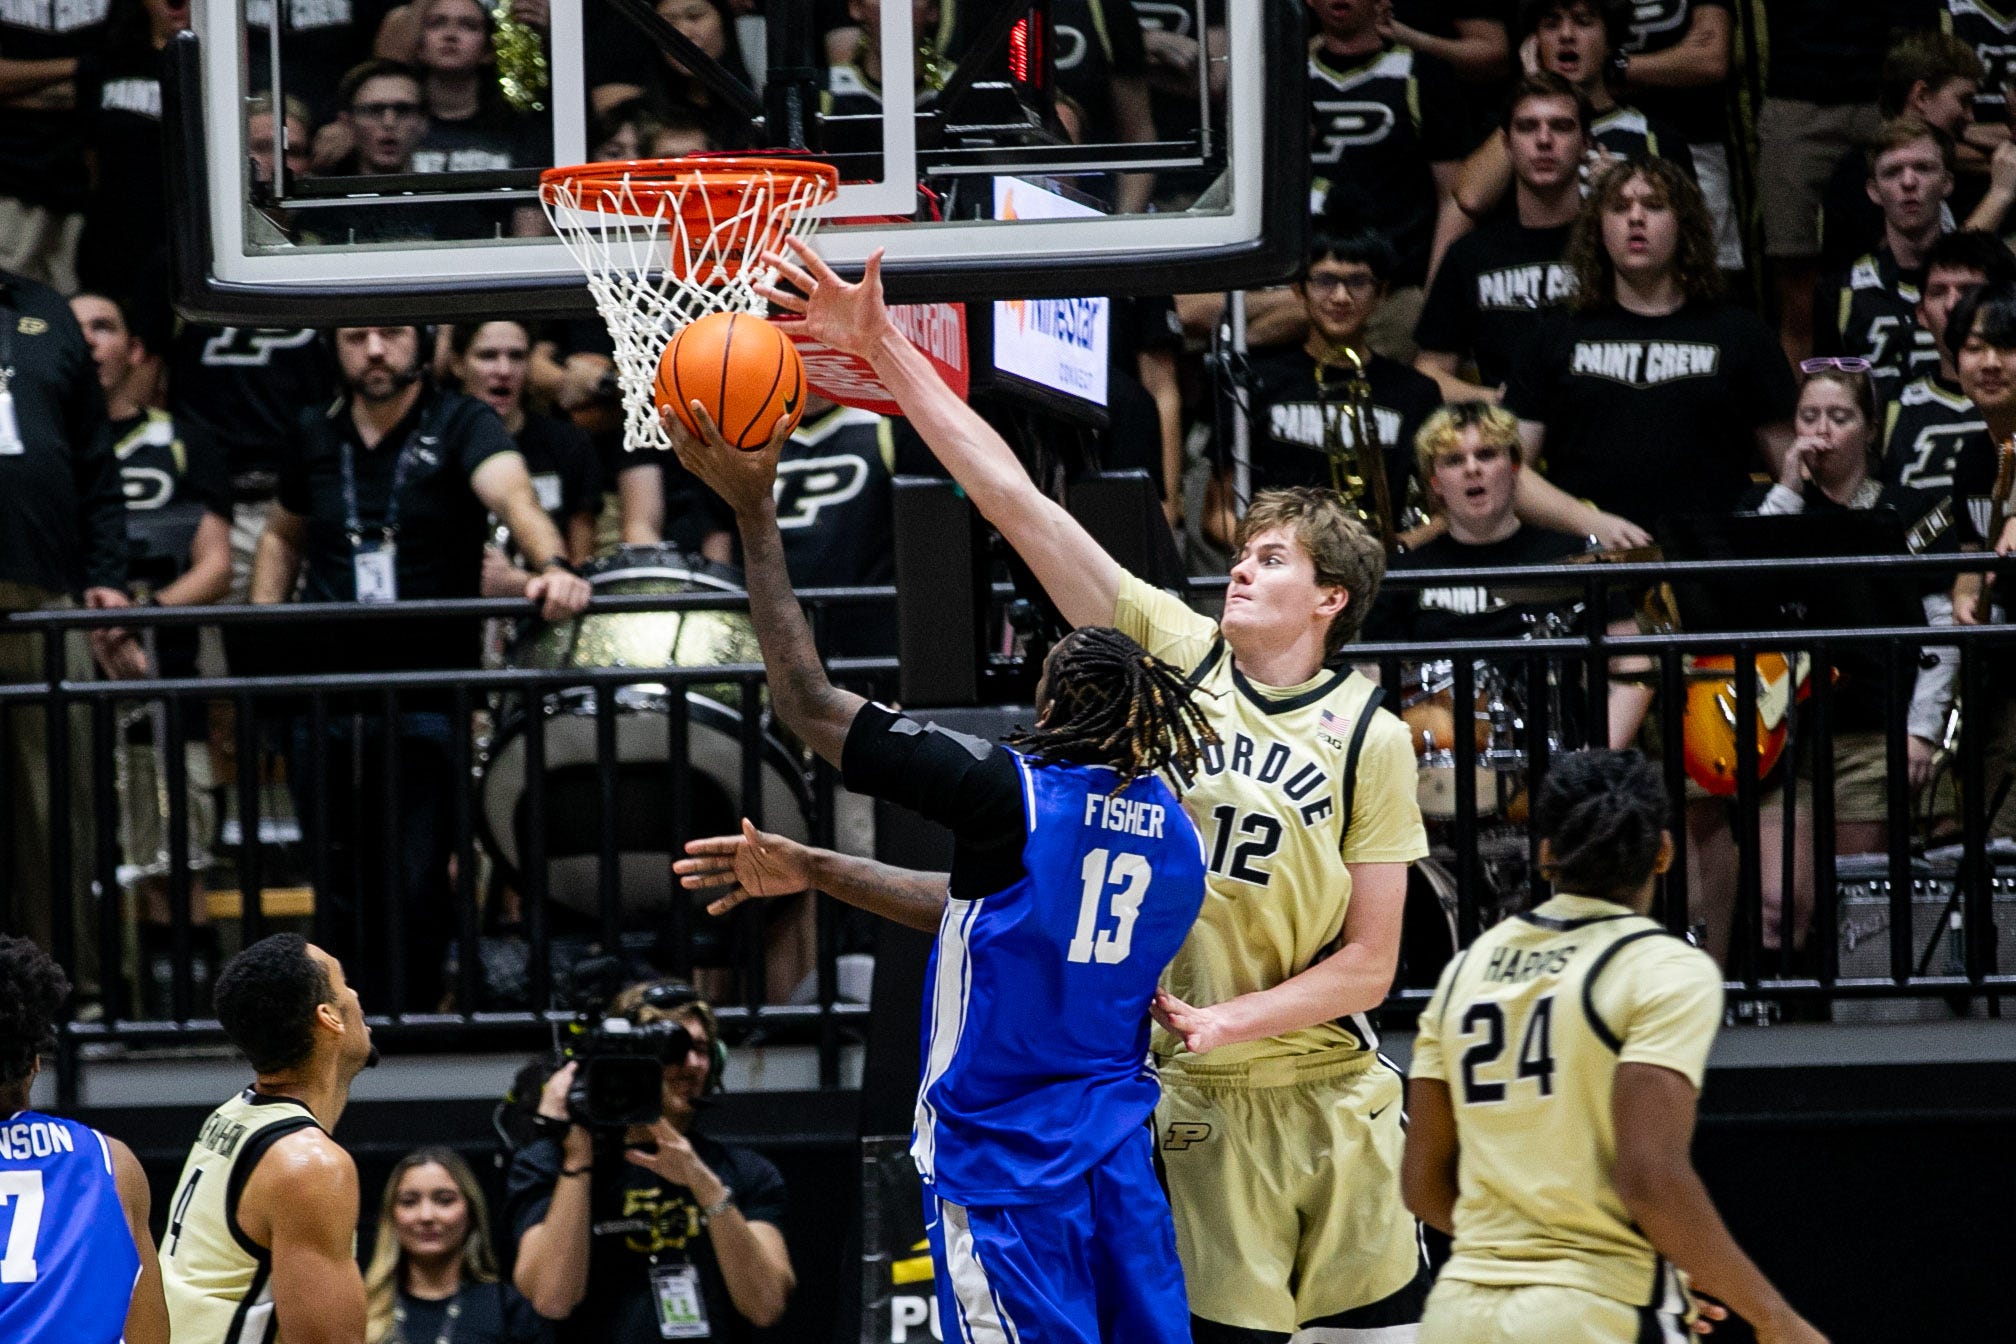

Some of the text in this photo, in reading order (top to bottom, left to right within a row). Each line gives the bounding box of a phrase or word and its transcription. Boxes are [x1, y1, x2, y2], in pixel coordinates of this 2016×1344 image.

[1574, 342, 1718, 384] PAINT CREW
[1084, 793, 1166, 839] FISHER
[1208, 803, 1284, 888] 12
[1067, 847, 1152, 965] 13
[1460, 995, 1557, 1104] 24
[1163, 1121, 1212, 1151] P
[170, 1168, 204, 1257] 4
